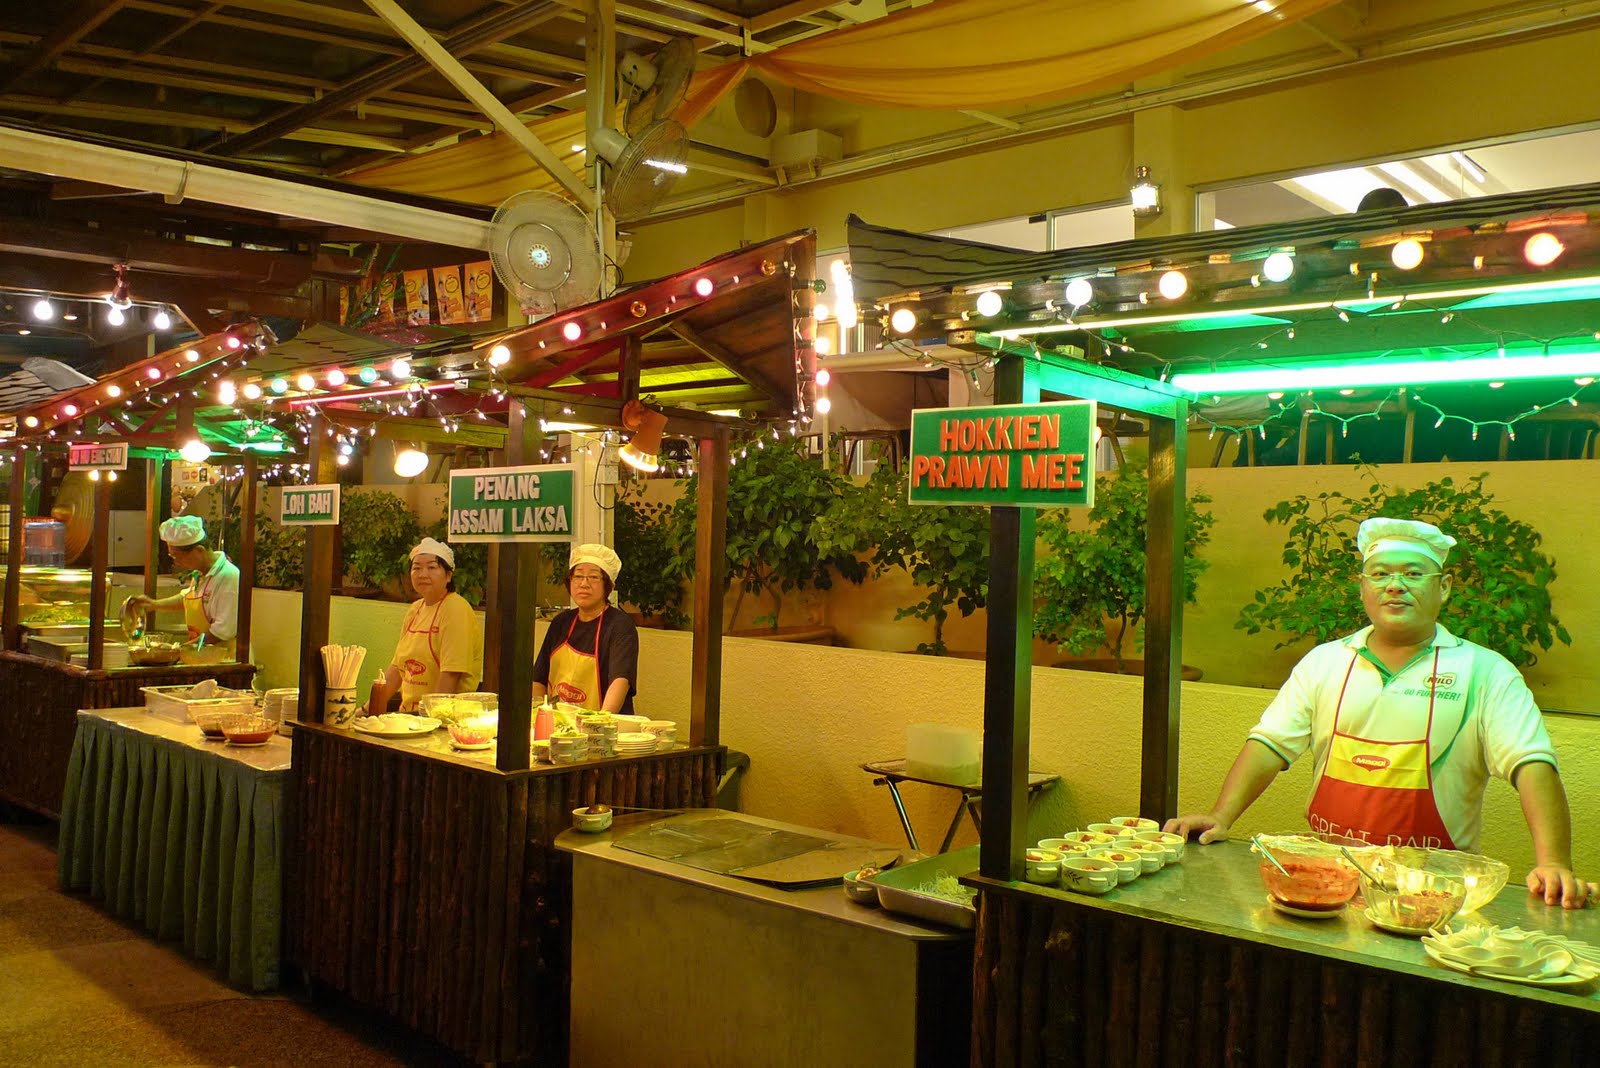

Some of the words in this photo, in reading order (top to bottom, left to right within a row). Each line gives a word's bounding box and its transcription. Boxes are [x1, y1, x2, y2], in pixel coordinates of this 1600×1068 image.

[940, 414, 1060, 452] HOKKIEN
[912, 455, 1009, 489] PRAWN
[1021, 453, 1084, 489] MEE
[474, 474, 540, 500] PENANG
[283, 494, 305, 514] LOH
[308, 492, 331, 514] BAH
[450, 508, 504, 533] ASSAM
[511, 505, 568, 532] LAKSA
